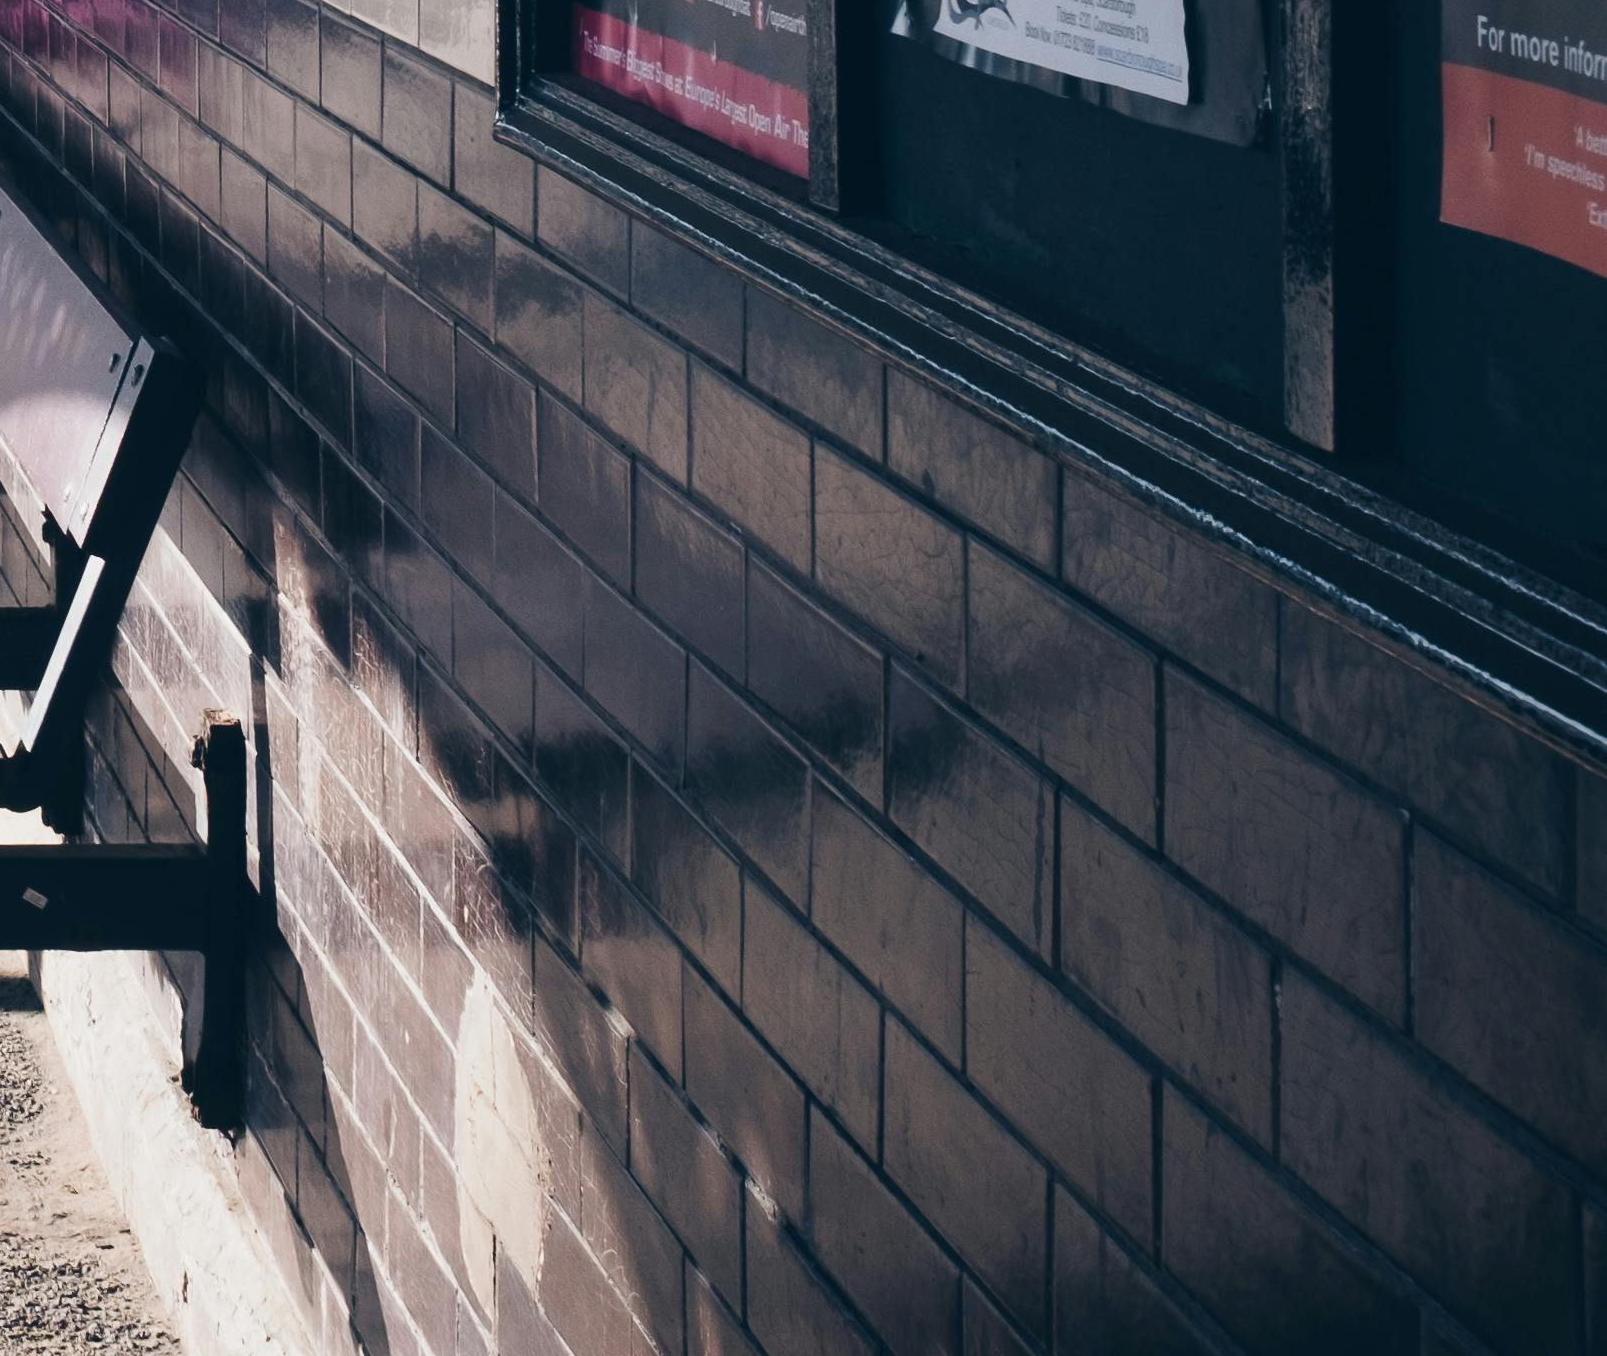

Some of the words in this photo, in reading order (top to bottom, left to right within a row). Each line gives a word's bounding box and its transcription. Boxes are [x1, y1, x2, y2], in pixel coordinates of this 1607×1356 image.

[1477, 14, 1505, 53] For
[1510, 31, 1560, 68] more
[747, 104, 772, 138] Open
[774, 113, 790, 141] Air
[1547, 155, 1606, 193] speechless
